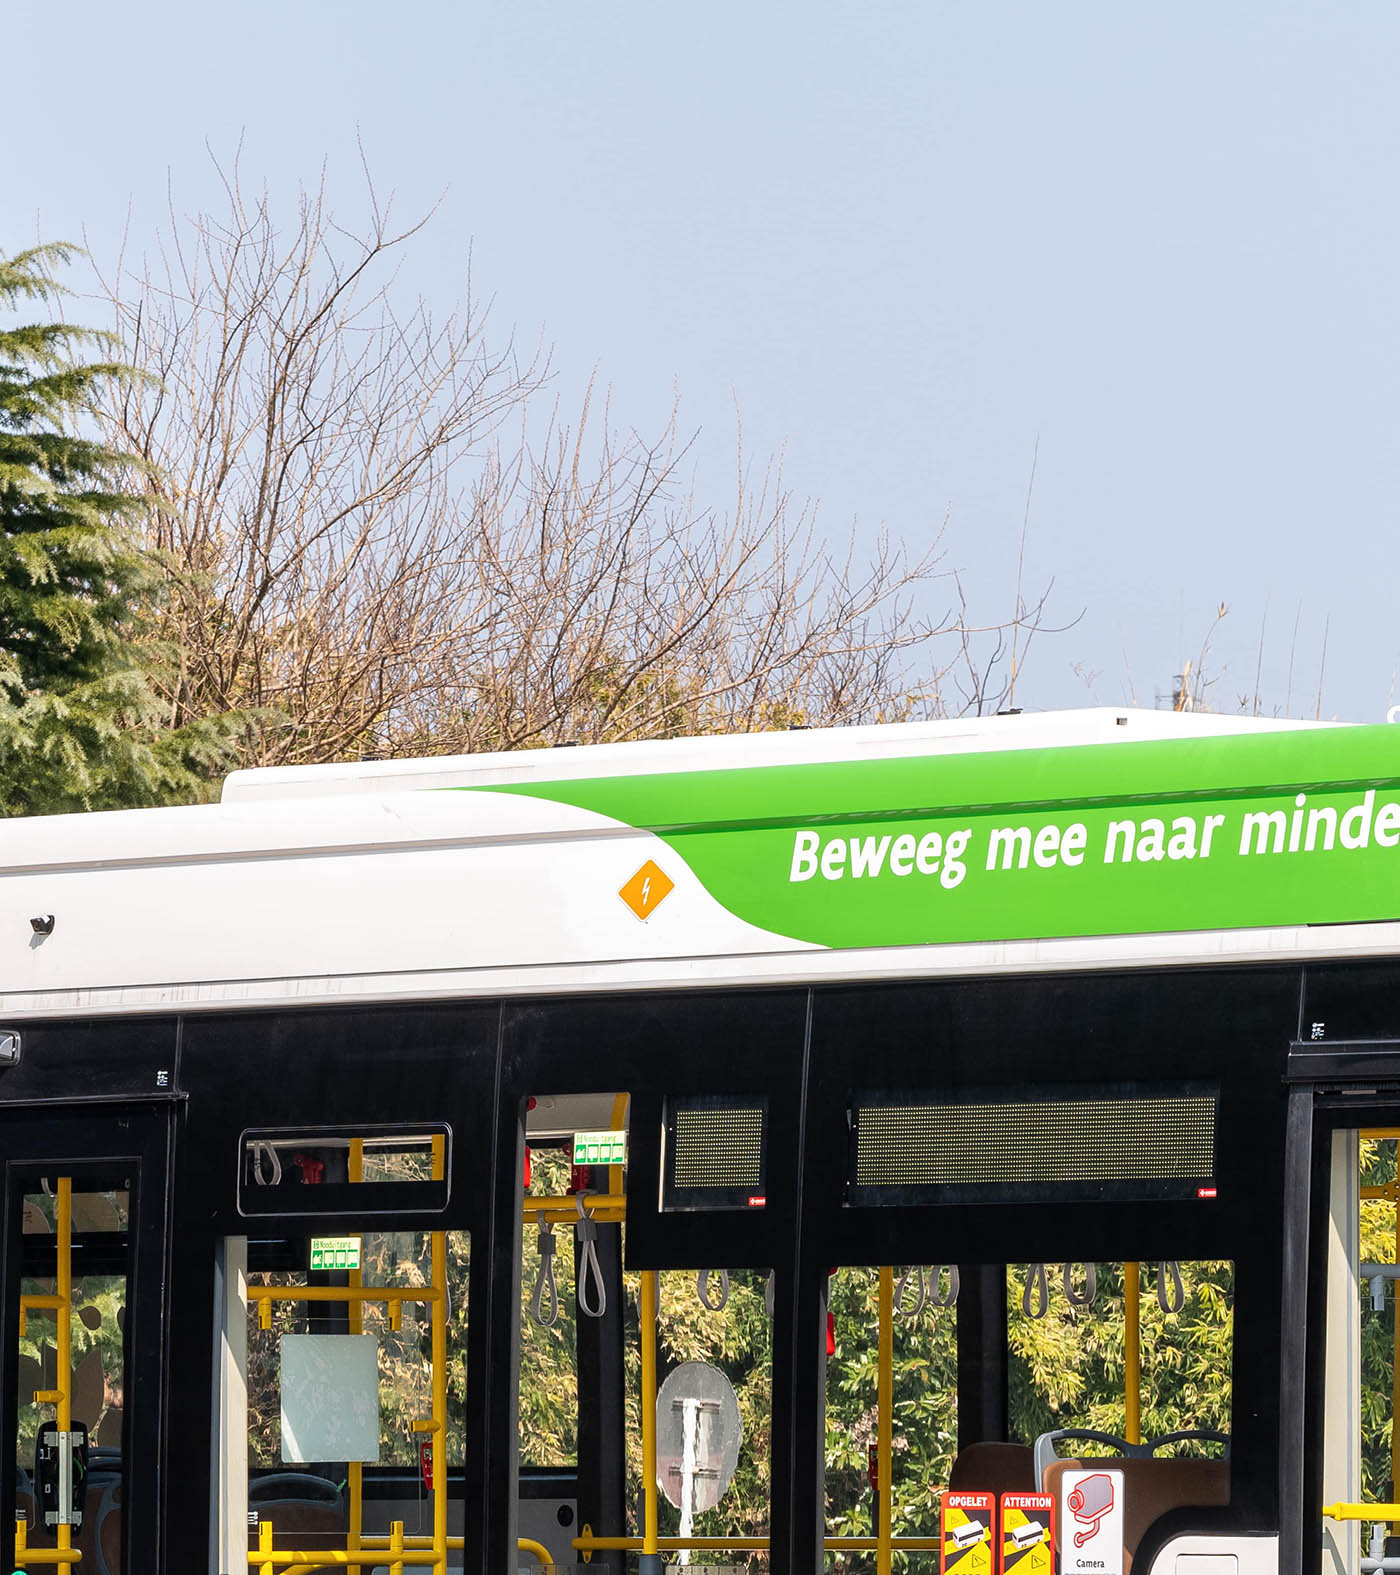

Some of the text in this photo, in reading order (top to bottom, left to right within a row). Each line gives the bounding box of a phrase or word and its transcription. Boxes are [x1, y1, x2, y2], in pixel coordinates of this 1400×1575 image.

[790, 829, 972, 889] Beweeg
[986, 823, 1088, 871] mee
[1104, 814, 1226, 864] naar
[949, 1496, 988, 1507] OPGELET
[1004, 1496, 1052, 1507] ATTENTION
[1076, 1559, 1105, 1568] Camera
